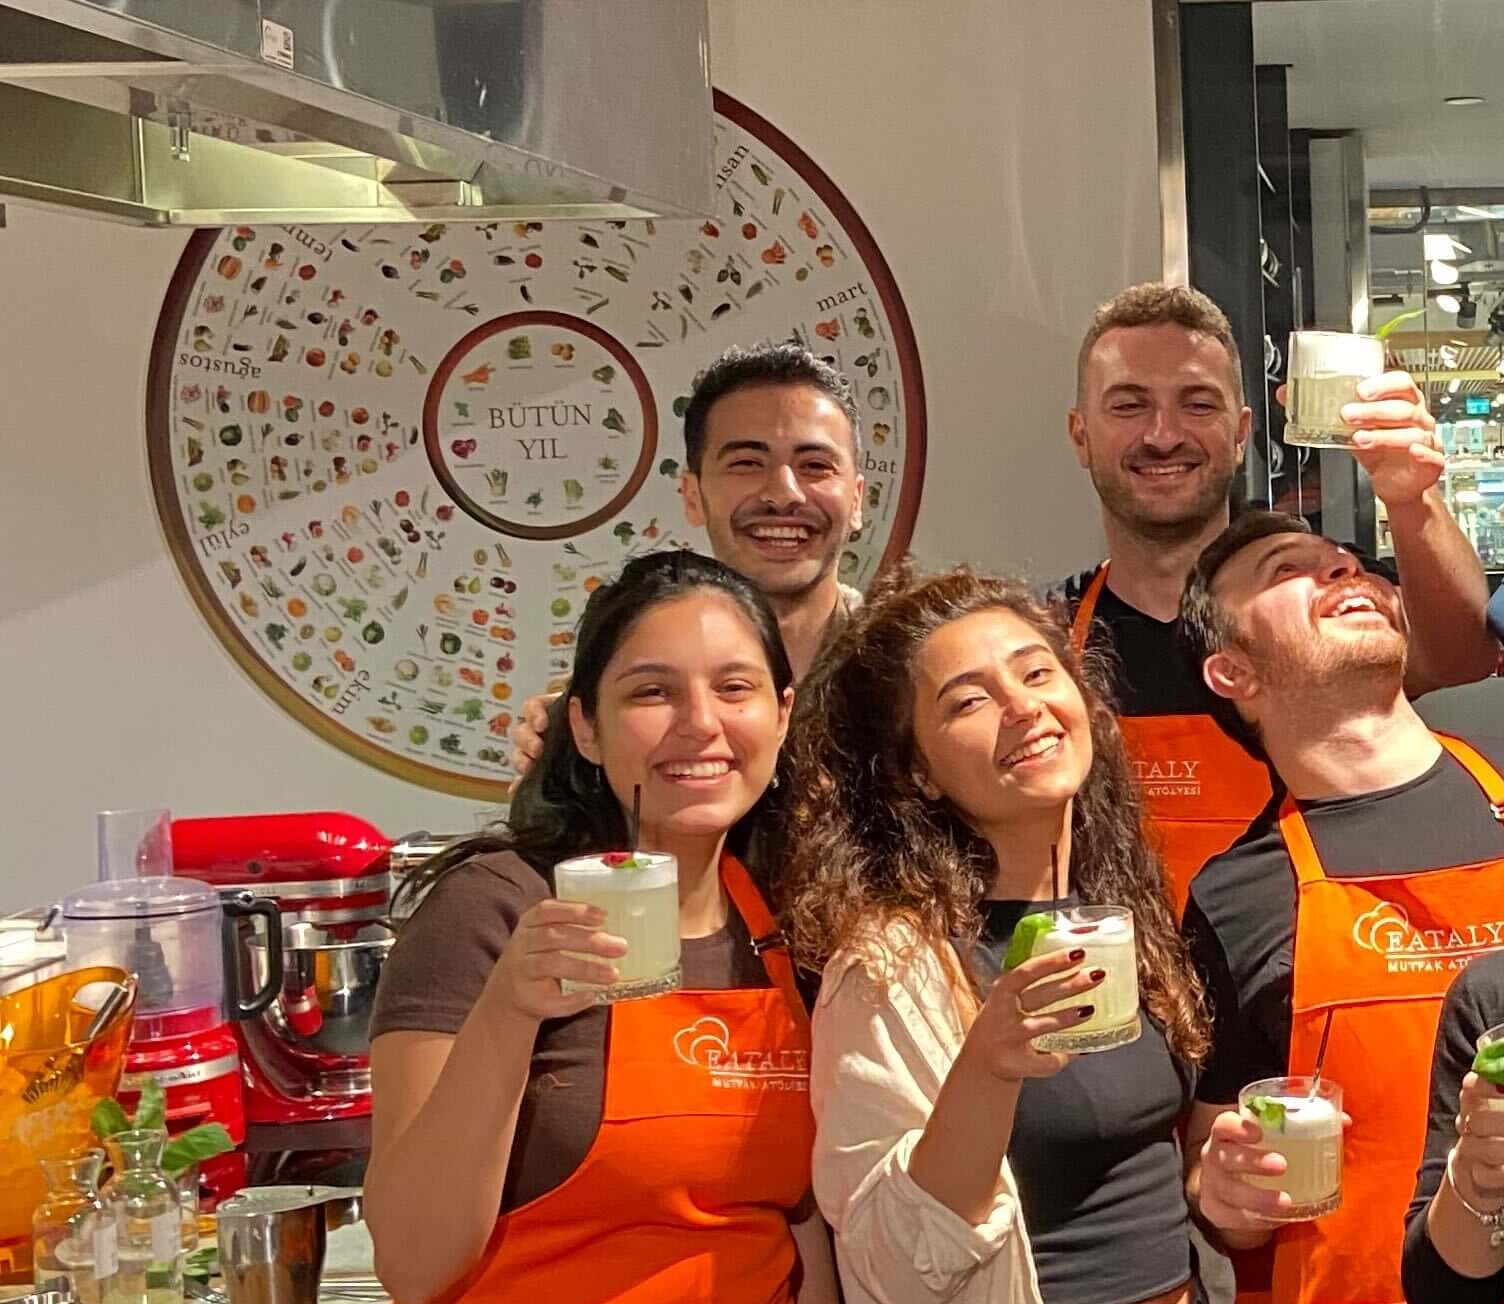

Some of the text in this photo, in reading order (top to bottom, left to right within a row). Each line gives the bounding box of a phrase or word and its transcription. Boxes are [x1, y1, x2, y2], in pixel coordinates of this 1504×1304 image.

[815, 281, 869, 312] mart
[179, 352, 262, 379] ağustos
[487, 400, 593, 429] BÜTÜN
[515, 438, 568, 460] YIL
[864, 451, 897, 475] bat
[199, 519, 250, 558] eylül
[331, 669, 372, 715] ekim
[1131, 760, 1200, 779] TALY
[1387, 959, 1444, 973] MUTFAK
[705, 1049, 808, 1072] EATALY
